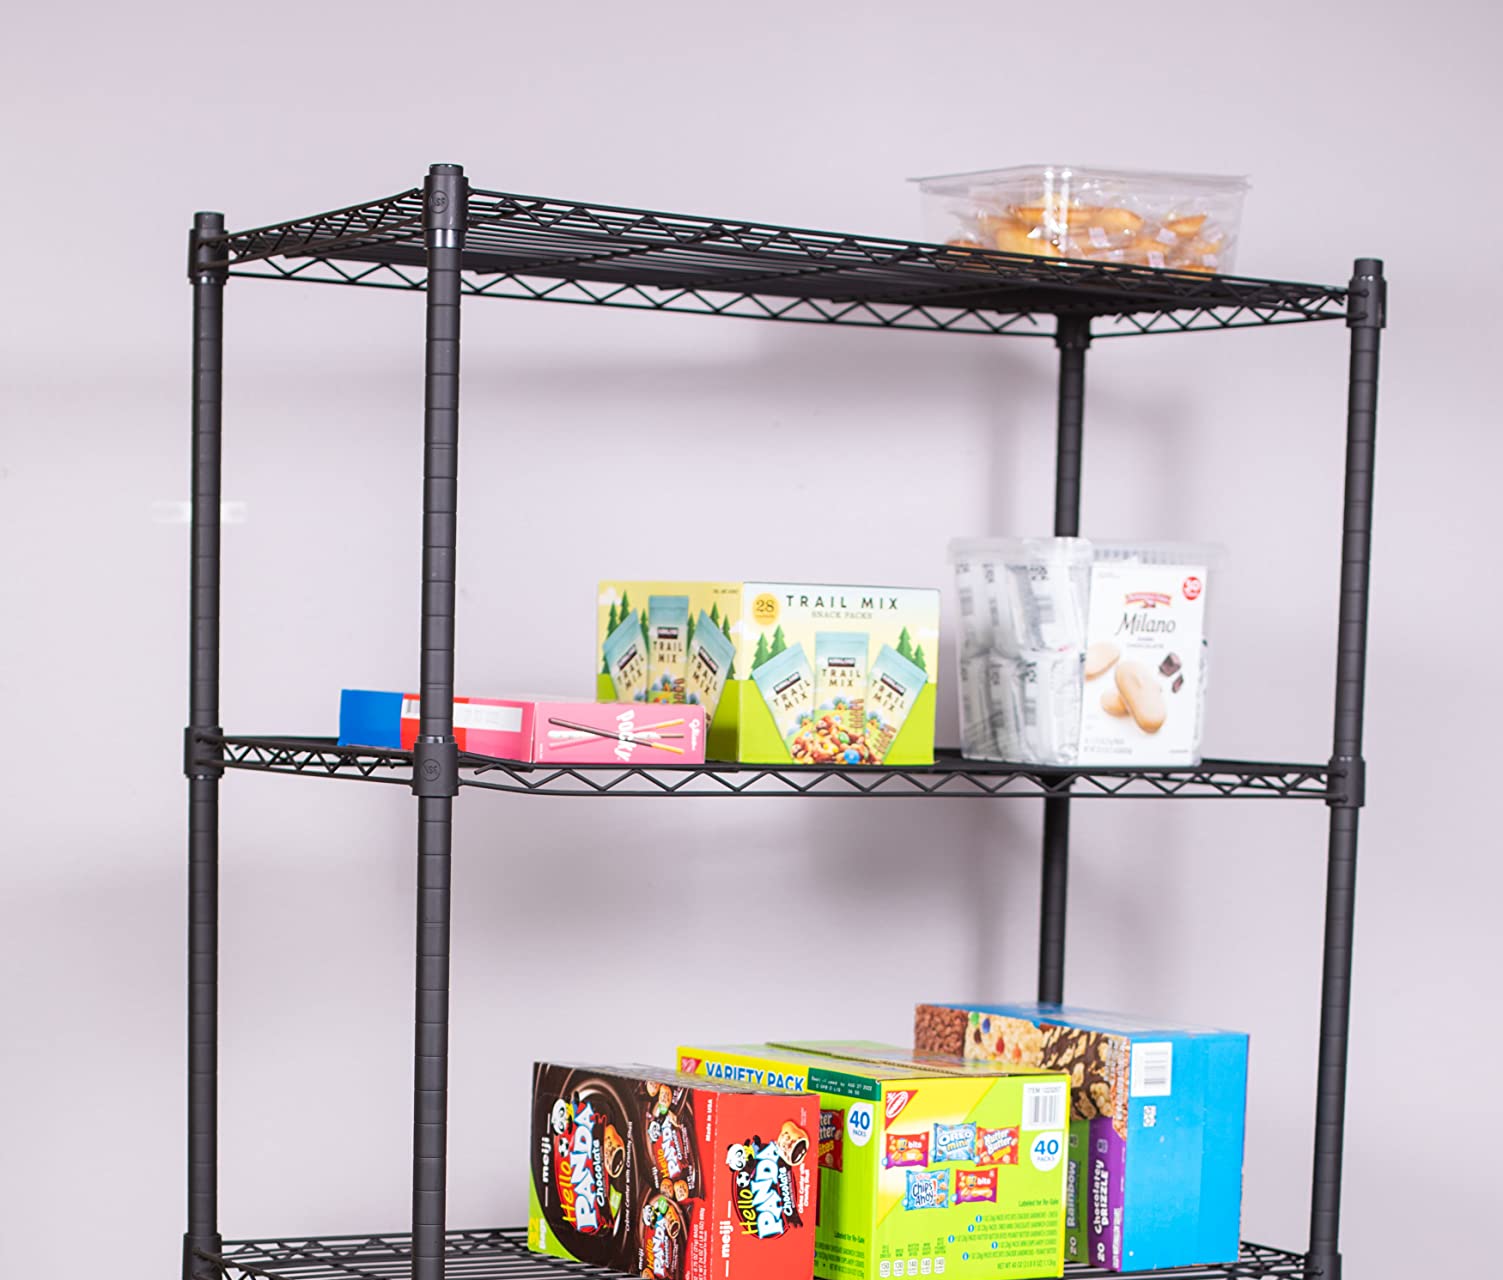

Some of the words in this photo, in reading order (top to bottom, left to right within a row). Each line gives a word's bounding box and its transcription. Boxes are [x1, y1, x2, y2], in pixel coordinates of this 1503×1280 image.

[755, 599, 775, 613] 28
[786, 595, 848, 609] TRAIL
[861, 597, 898, 610] MIX
[844, 611, 873, 620] PACKS
[1114, 612, 1176, 636] Milano
[653, 640, 683, 652] TRAIL
[657, 654, 677, 664] MIX
[822, 668, 861, 679] TRAIL
[829, 679, 854, 688] MIX
[772, 679, 811, 707] TRAIL
[784, 692, 809, 712] MIX
[871, 679, 906, 709] TRAIL
[873, 692, 896, 713] MIX
[705, 1061, 765, 1085] VARIETY
[767, 1071, 805, 1092] PACK
[849, 1110, 871, 1130] 40
[661, 1114, 682, 1179] PANDA
[938, 1130, 974, 1146] OREO
[1034, 1140, 1059, 1155] 40
[541, 1136, 552, 1184] meiji
[569, 1101, 599, 1231] PANDA
[592, 1139, 606, 1208] Chocolate
[657, 1148, 670, 1178] Hello
[560, 1160, 577, 1223] Hello
[750, 1141, 785, 1239] PANDA
[778, 1166, 793, 1216] Chocolate
[1066, 1161, 1077, 1228] Rainbow
[1092, 1159, 1105, 1235] Chocolatey
[1100, 1170, 1109, 1227] DRIZZLE
[738, 1188, 758, 1235] Hello
[653, 1214, 667, 1277] PANDA
[719, 1220, 734, 1258] meiji
[1096, 1242, 1106, 1263] 20
